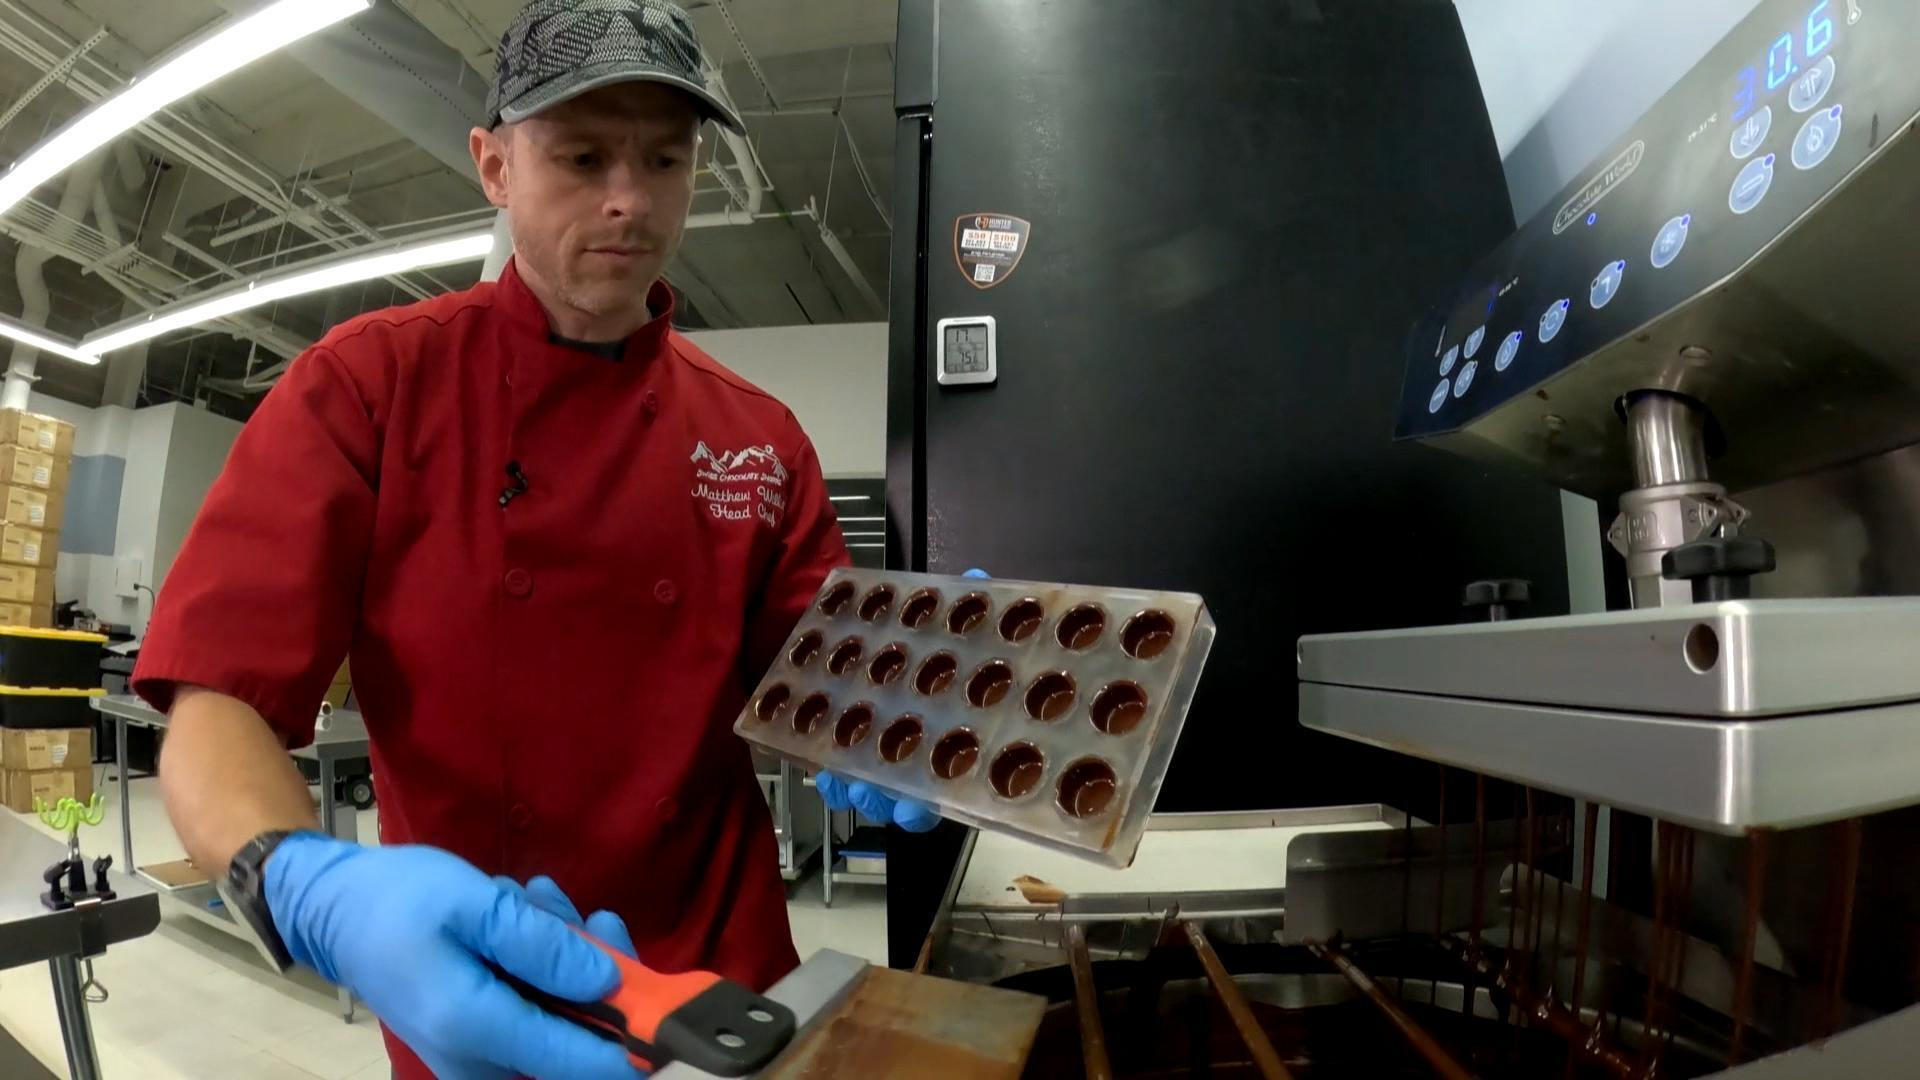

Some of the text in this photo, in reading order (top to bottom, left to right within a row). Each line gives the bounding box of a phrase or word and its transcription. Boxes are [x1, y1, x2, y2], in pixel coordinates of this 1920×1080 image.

[1732, 0, 1836, 121] 30.6
[691, 484, 752, 502] Matthew
[709, 504, 752, 519] Head
